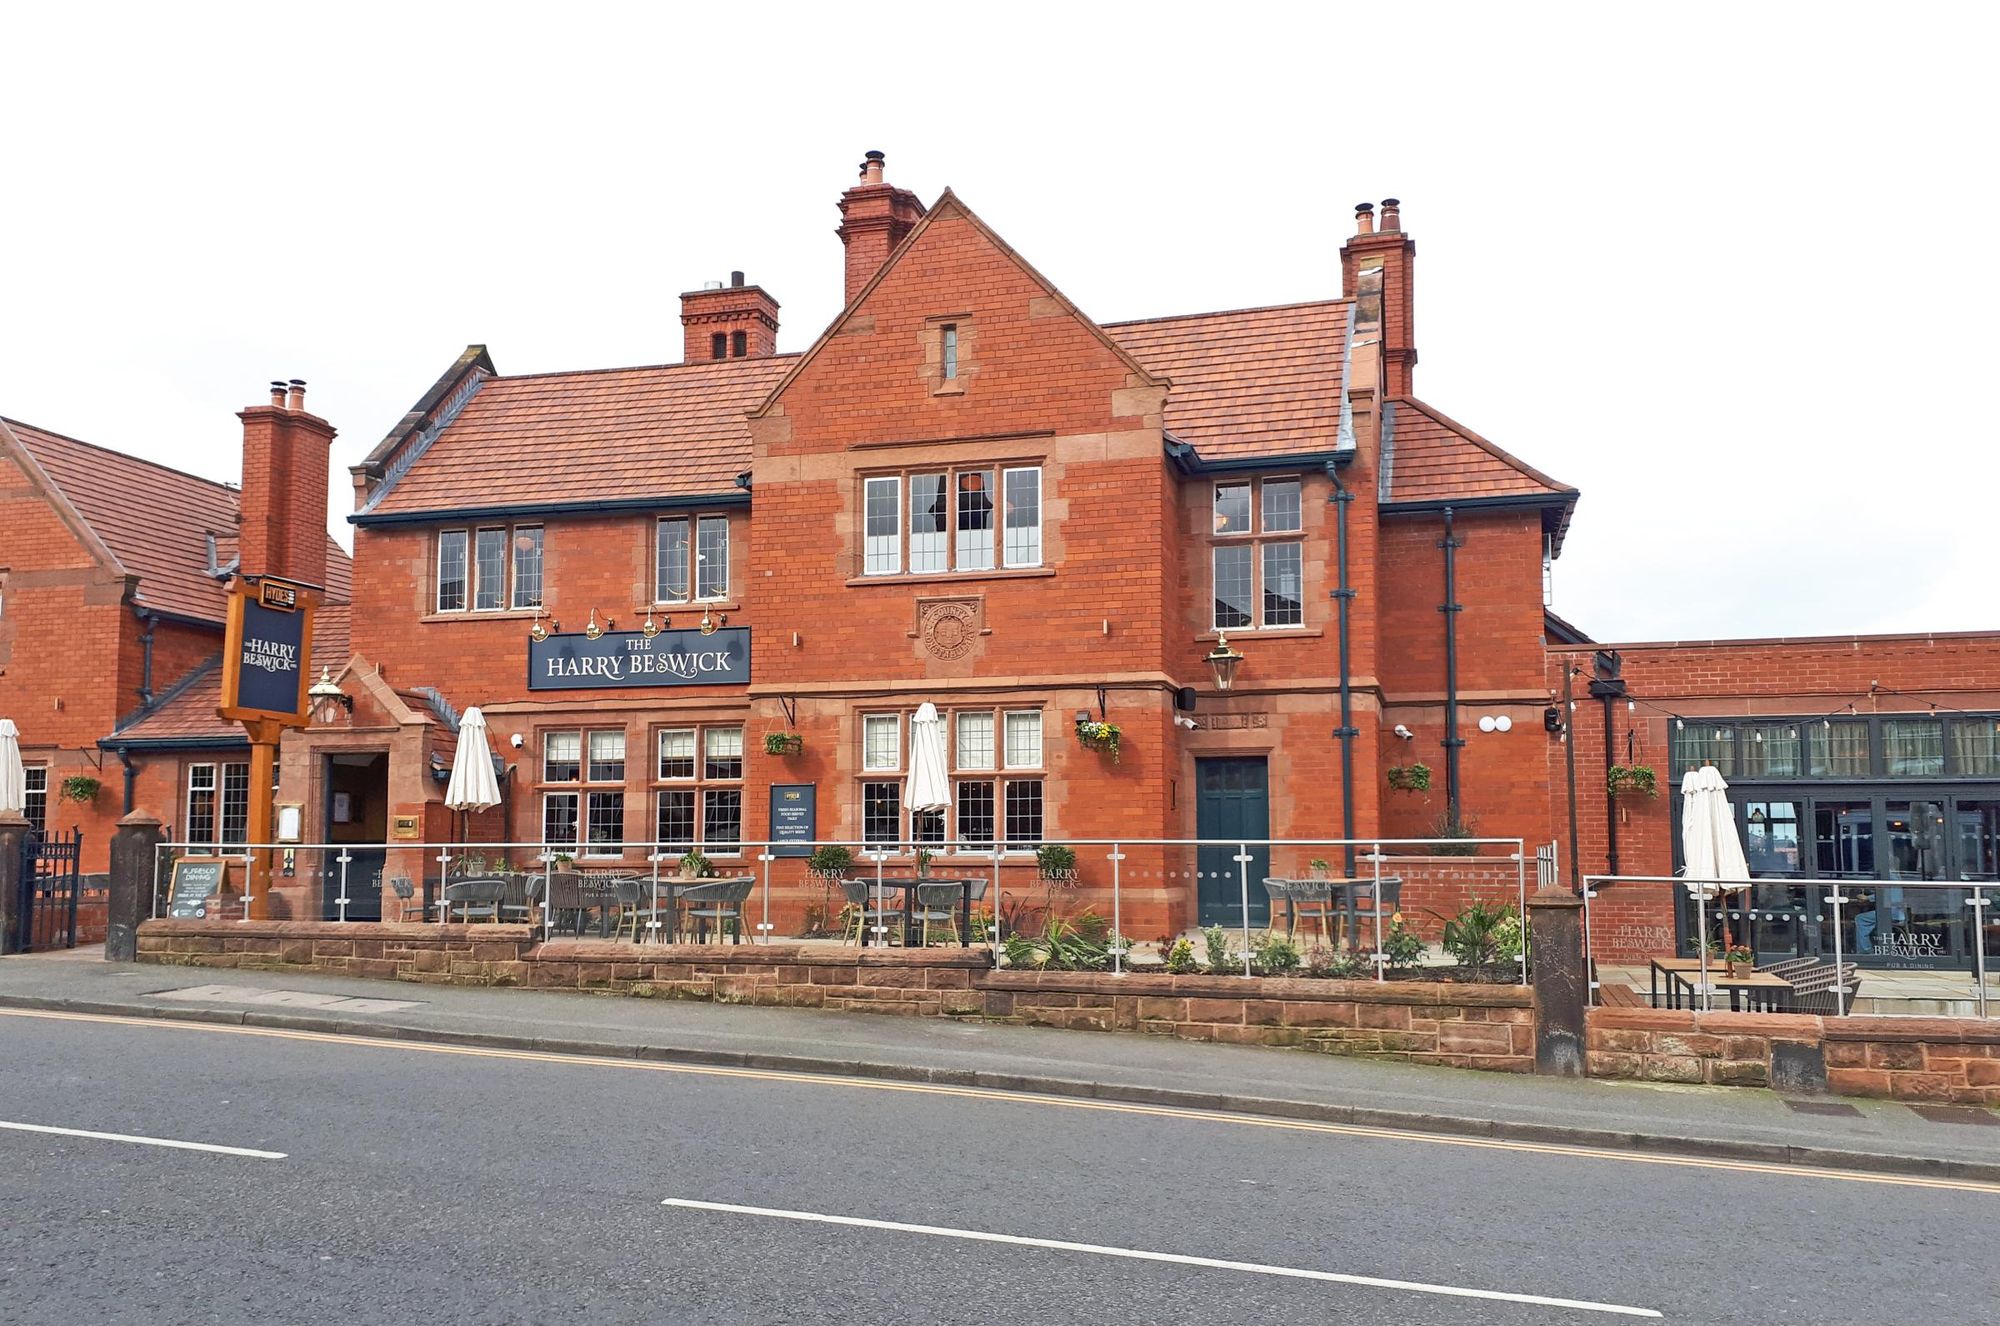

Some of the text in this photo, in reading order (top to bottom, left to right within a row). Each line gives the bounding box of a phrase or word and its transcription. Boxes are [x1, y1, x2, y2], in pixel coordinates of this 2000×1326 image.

[265, 585, 289, 603] HYDES
[933, 606, 970, 620] COUNTY
[251, 638, 296, 663] HARRY
[626, 639, 651, 650] THE
[243, 652, 292, 672] BESWICK
[547, 652, 731, 681] HARRY BESWICK
[584, 869, 620, 880] HARRY
[805, 868, 846, 881] HARRY
[1036, 868, 1081, 882] HARRY
[578, 879, 619, 891] BESWICK
[1030, 880, 1077, 889] BEWICK
[1280, 881, 1332, 893] BESWICK
[1619, 925, 1673, 941] HARRY
[1612, 937, 1670, 953] BESWICK
[1882, 932, 1943, 950] HARRY
[1873, 943, 1938, 960] BESWICK
